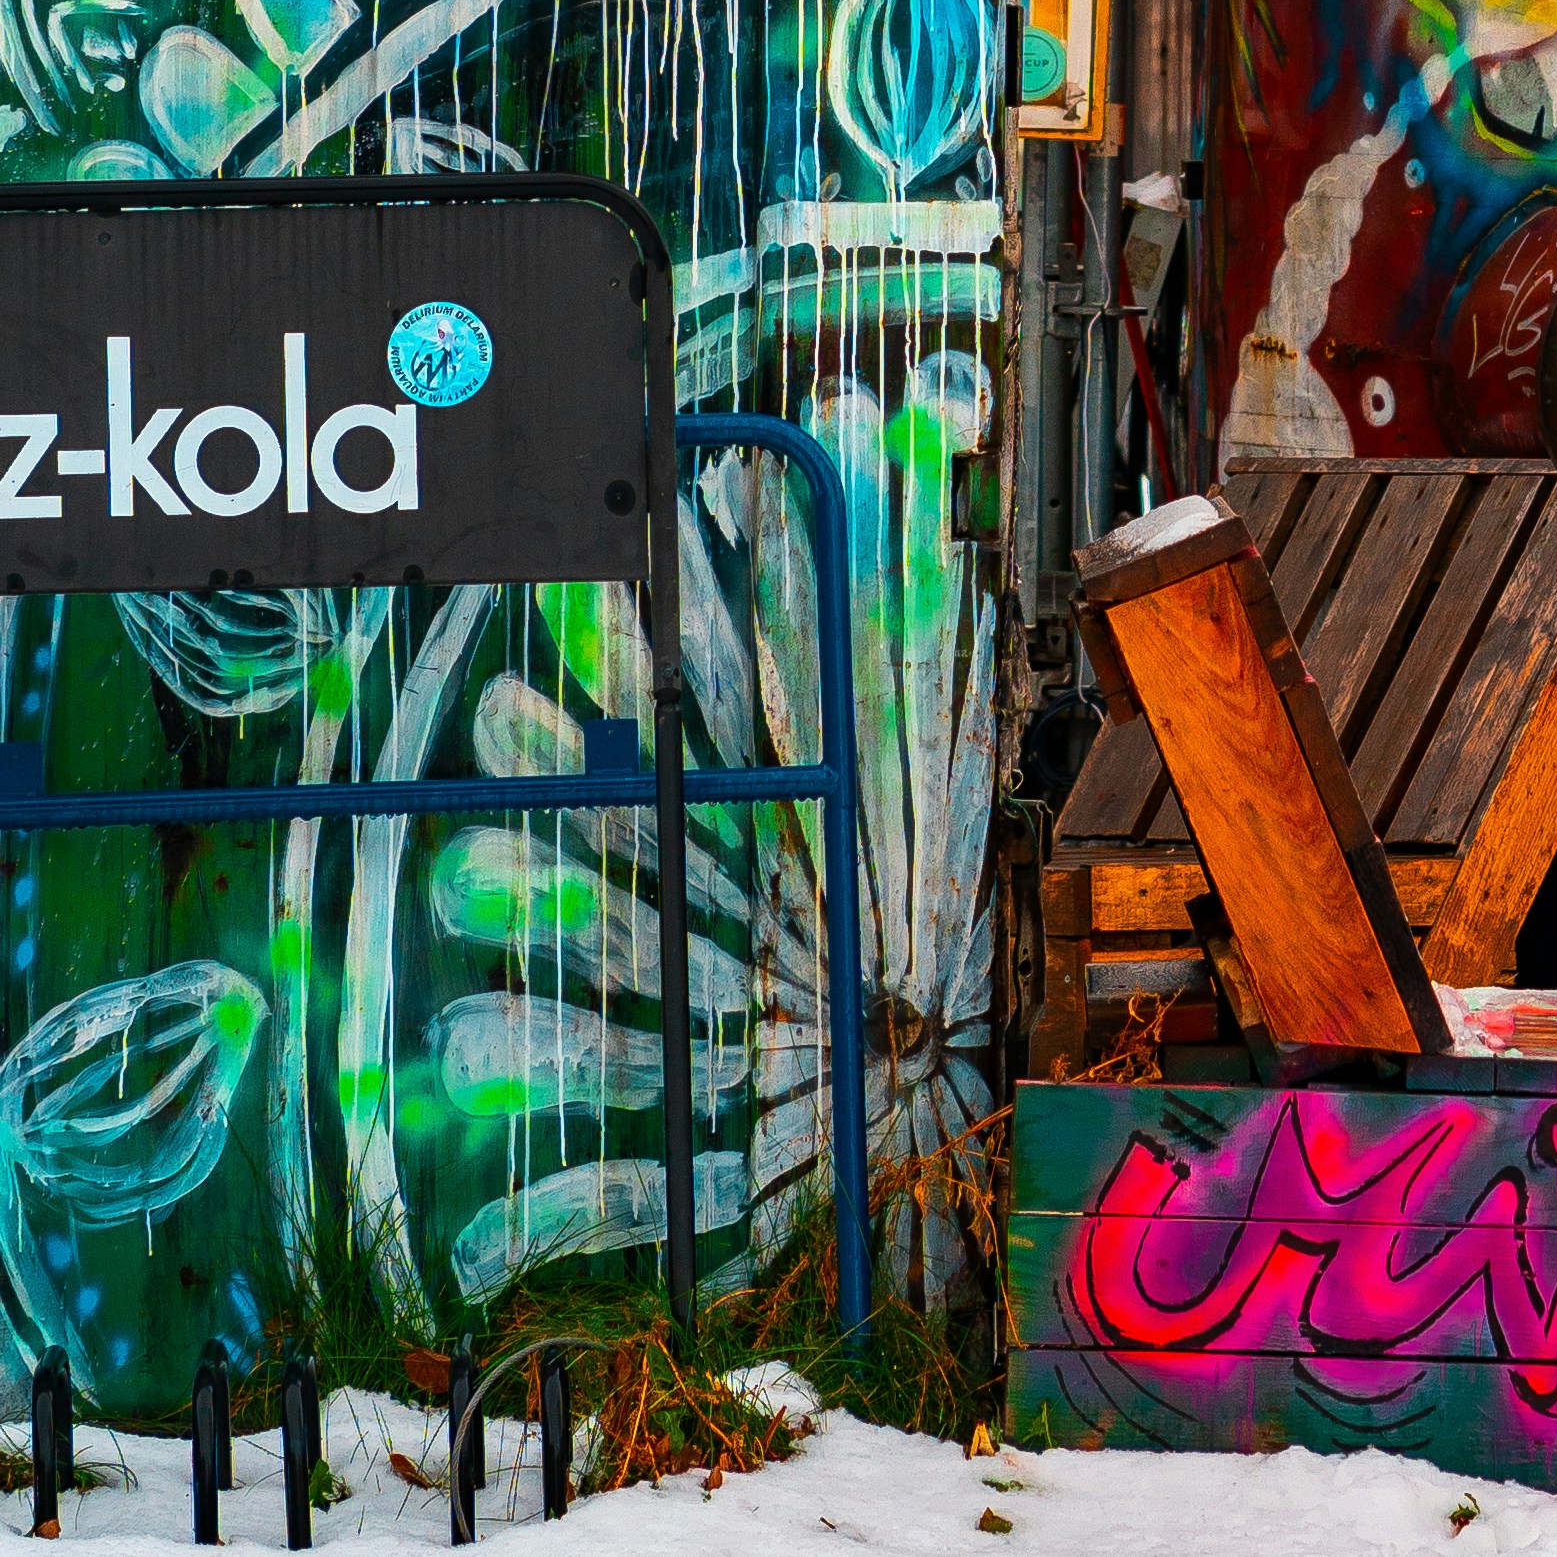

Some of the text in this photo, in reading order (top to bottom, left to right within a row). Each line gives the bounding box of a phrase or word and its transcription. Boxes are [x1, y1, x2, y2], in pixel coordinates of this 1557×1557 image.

[401, 305, 488, 362] DELIRIUM DELARIUM
[390, 345, 427, 399] AQUARIUM
[0, 332, 420, 518] z-kola
